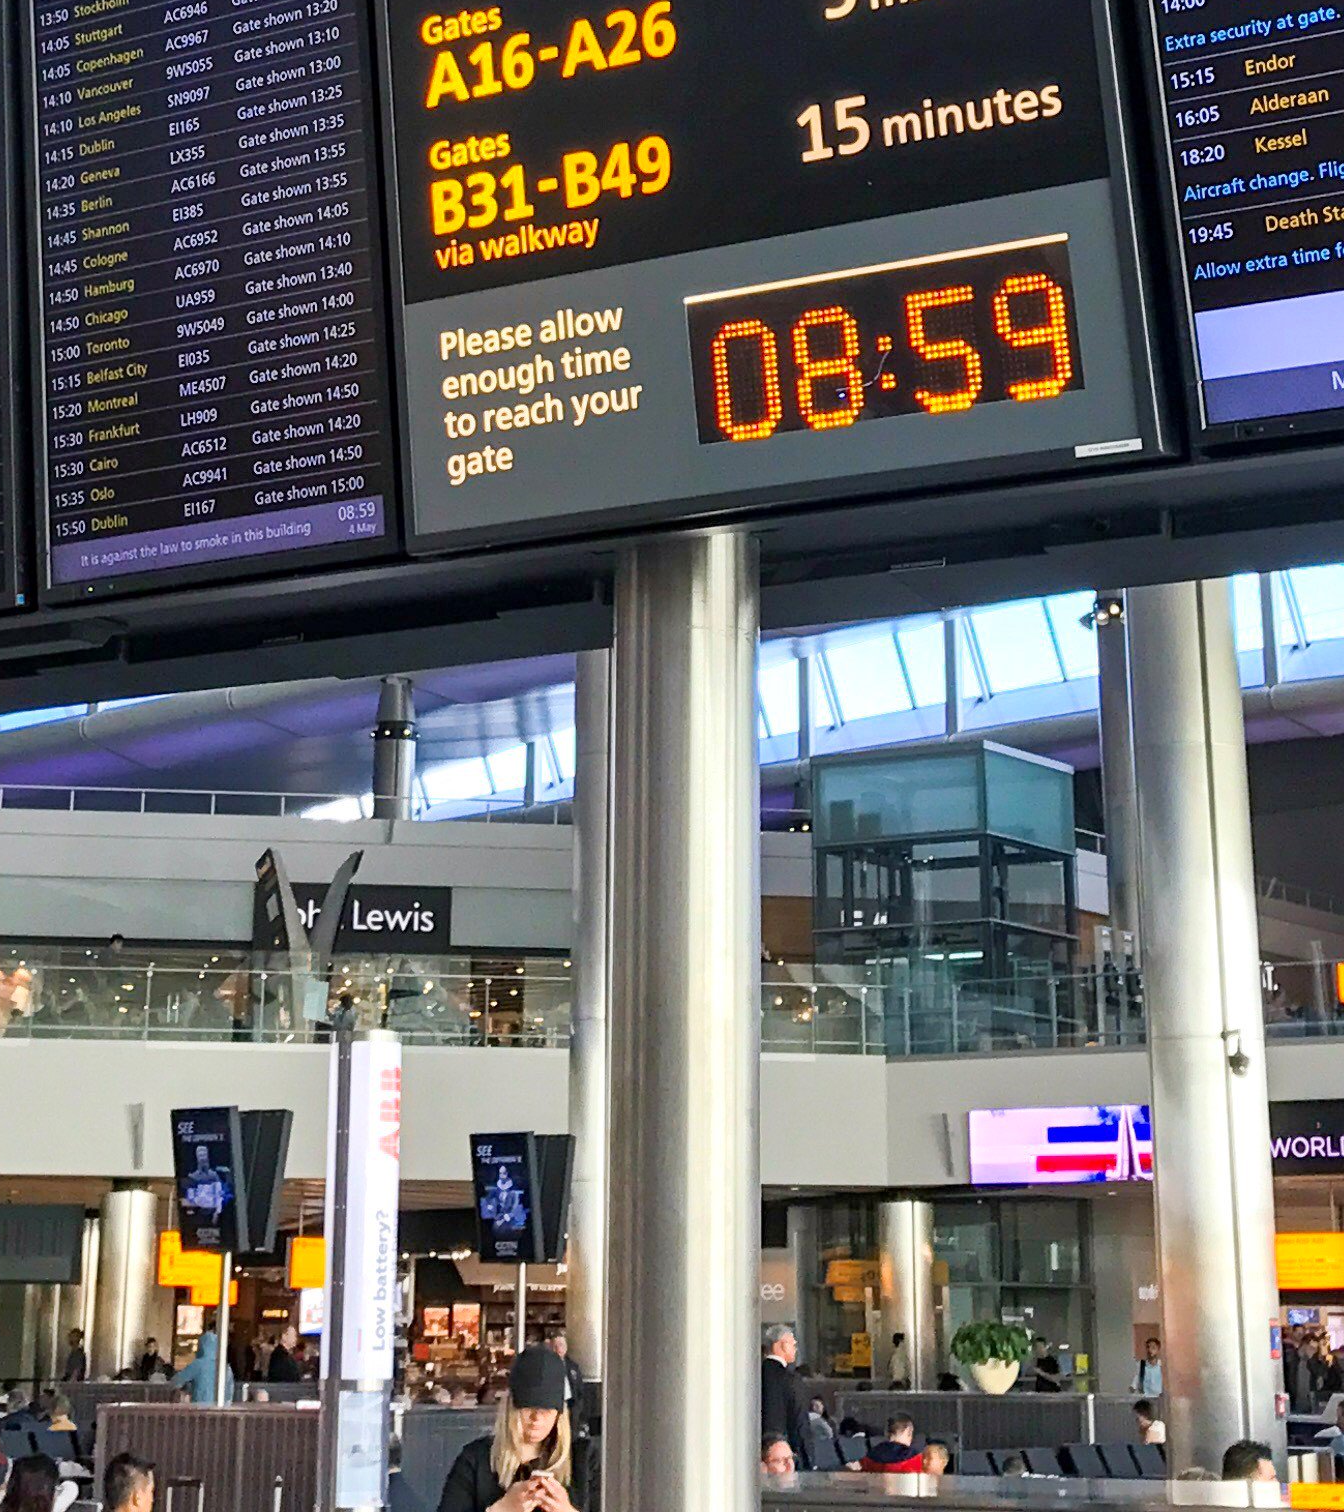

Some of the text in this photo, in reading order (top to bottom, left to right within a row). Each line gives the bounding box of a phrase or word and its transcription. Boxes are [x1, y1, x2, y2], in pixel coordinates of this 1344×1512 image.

[422, 4, 502, 45] Gates
[425, 1, 678, 109] A16-A26
[1170, 66, 1215, 89] 15:15
[1244, 54, 1295, 75] Endor
[795, 80, 1063, 163] 15 minutes
[1175, 105, 1220, 127] 16:05
[1250, 89, 1329, 114] Alderaan
[429, 130, 511, 170] Gates
[1180, 144, 1225, 166] 18:20
[1255, 128, 1307, 153] Kessel
[429, 134, 672, 236] B31-B49
[435, 213, 600, 270] via walkway
[1188, 222, 1233, 243] 19:45
[1265, 208, 1318, 231] Death
[439, 305, 624, 361] Please allow
[711, 273, 1072, 441] 08:59
[52, 402, 82, 419] 15:20
[179, 375, 226, 396] ME4507
[249, 369, 278, 383] Gate
[281, 361, 320, 378] shown
[325, 352, 357, 370] 14:20
[441, 342, 631, 401] enough time
[444, 381, 643, 439] to reach your
[447, 445, 514, 485] gate
[352, 899, 435, 932] Lewis
[372, 1209, 391, 1351] Low battery?
